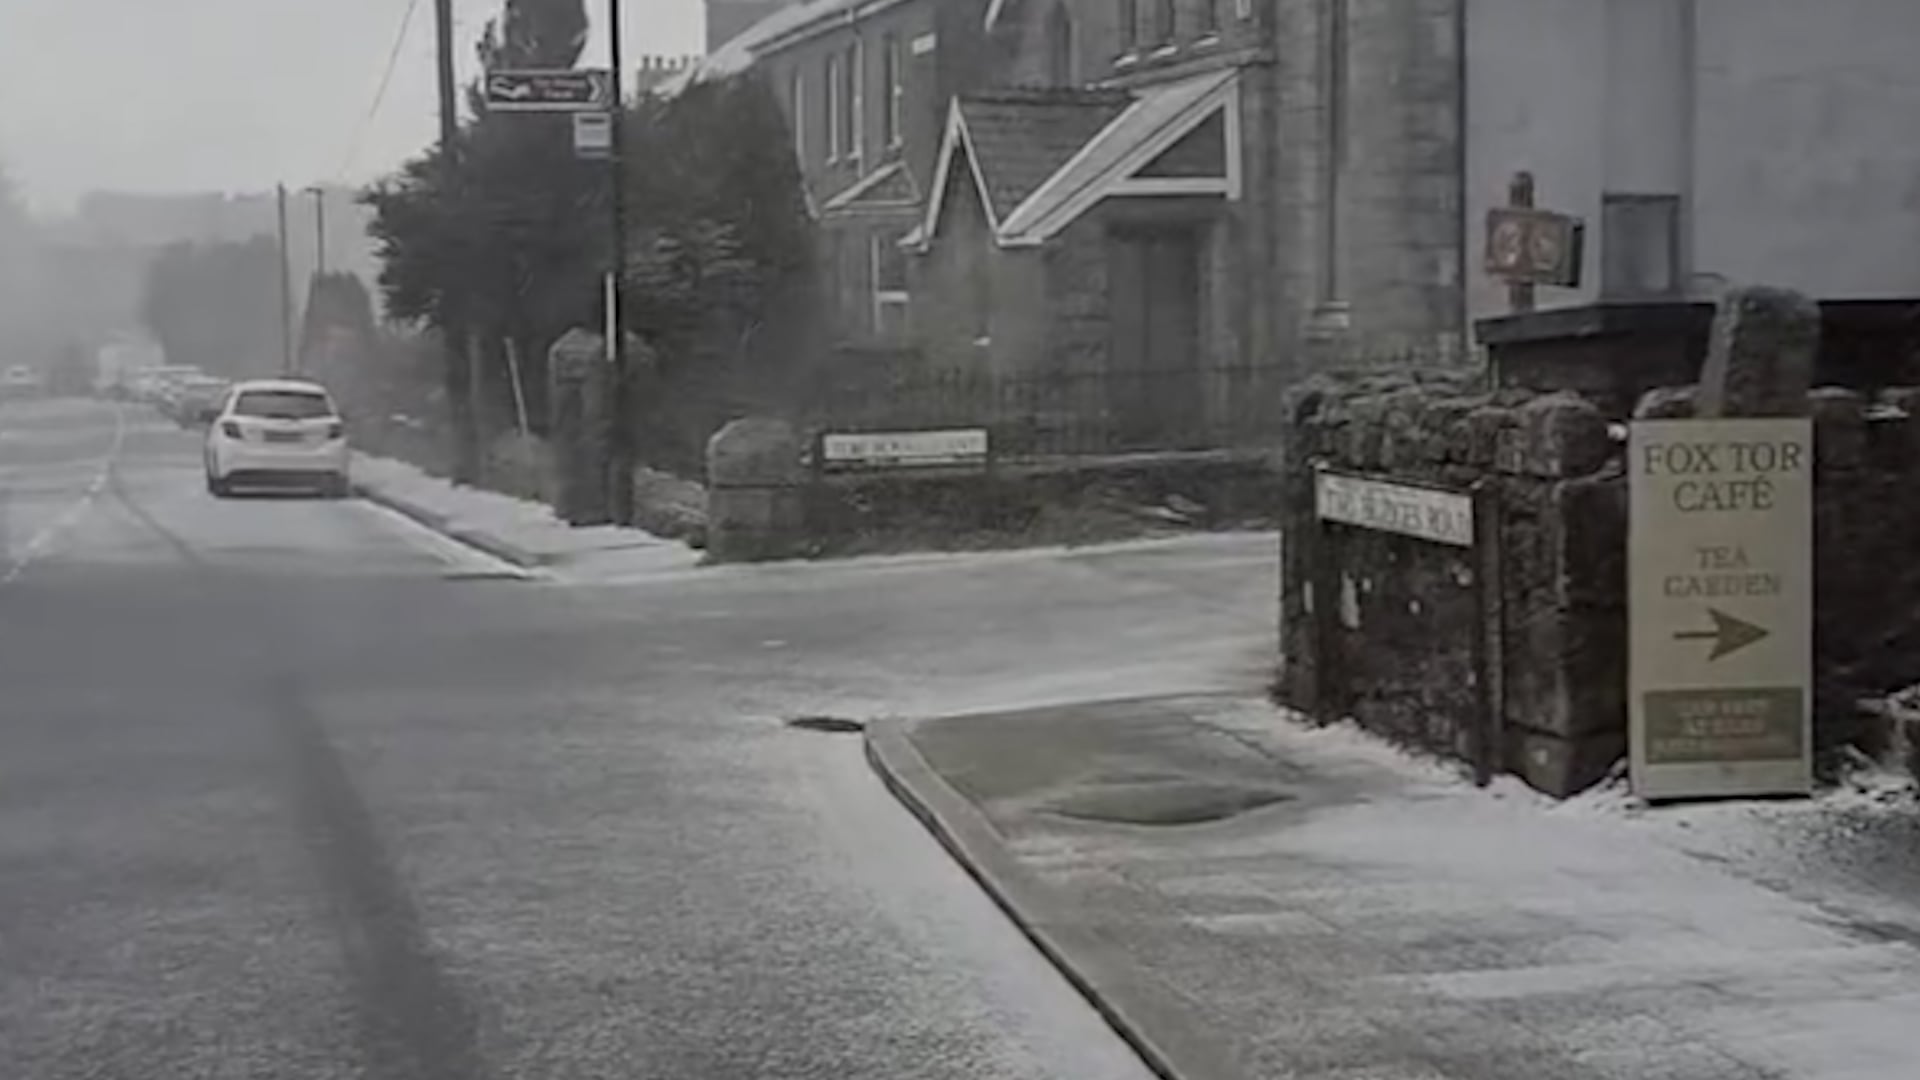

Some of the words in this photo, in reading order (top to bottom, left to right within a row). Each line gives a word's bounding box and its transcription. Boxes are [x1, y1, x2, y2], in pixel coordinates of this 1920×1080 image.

[1643, 442, 1719, 475] FOX
[1728, 440, 1803, 473] TOR
[1673, 474, 1776, 513] CAFÉ
[1696, 545, 1750, 570] TEA
[1663, 572, 1781, 598] GARDEN
